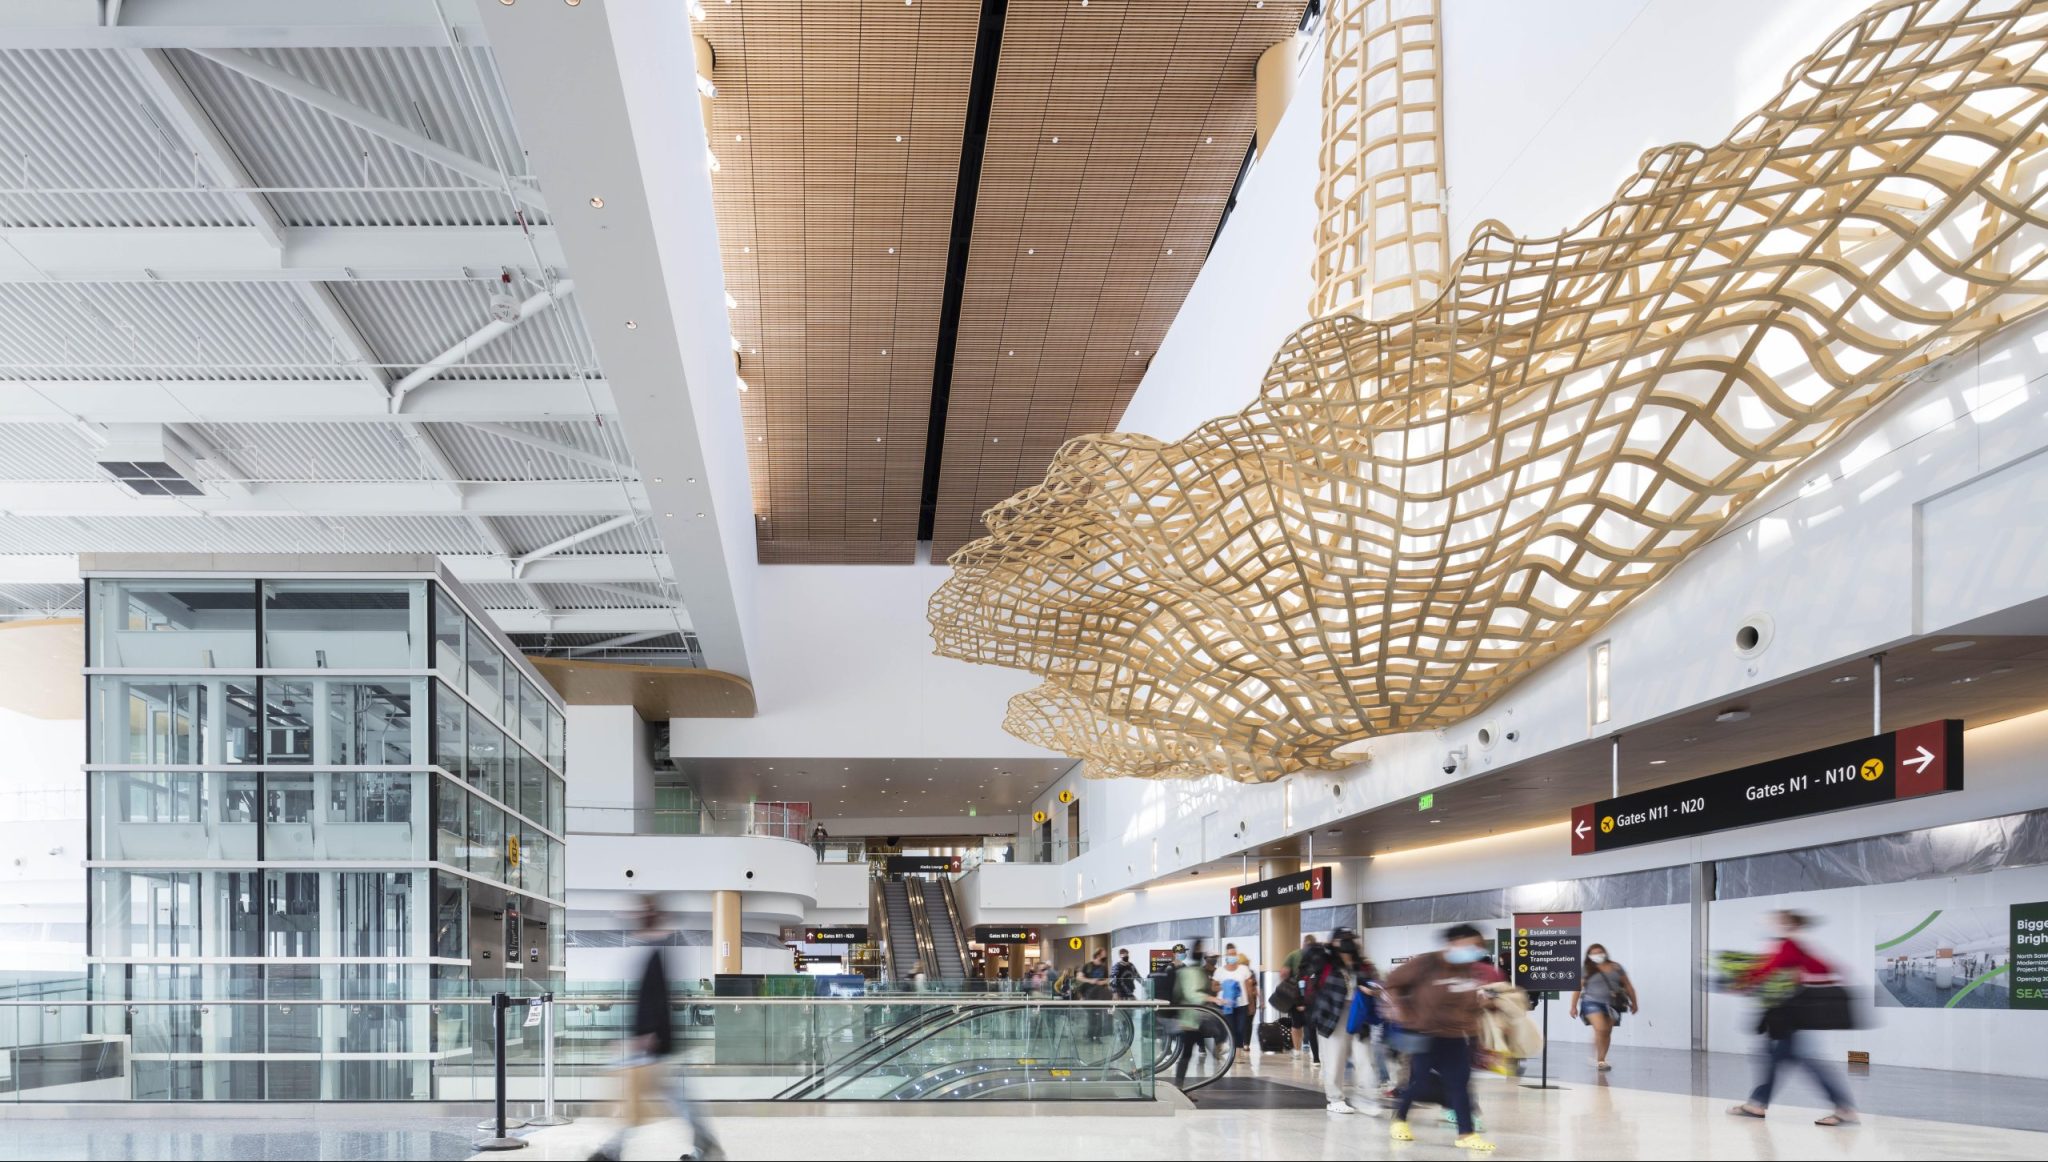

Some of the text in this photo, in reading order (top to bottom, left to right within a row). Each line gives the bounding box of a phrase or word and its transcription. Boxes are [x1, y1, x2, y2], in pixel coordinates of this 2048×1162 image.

[1746, 783, 1785, 800] Gates
[1790, 775, 1807, 792] N1
[1826, 765, 1856, 784] N10
[1617, 812, 1646, 827] Gates
[1649, 805, 1668, 821] N11
[1681, 797, 1705, 814] N20
[1277, 886, 1288, 895] Gates
[1243, 894, 1253, 902] Gates
[2016, 989, 2043, 999] SEA
